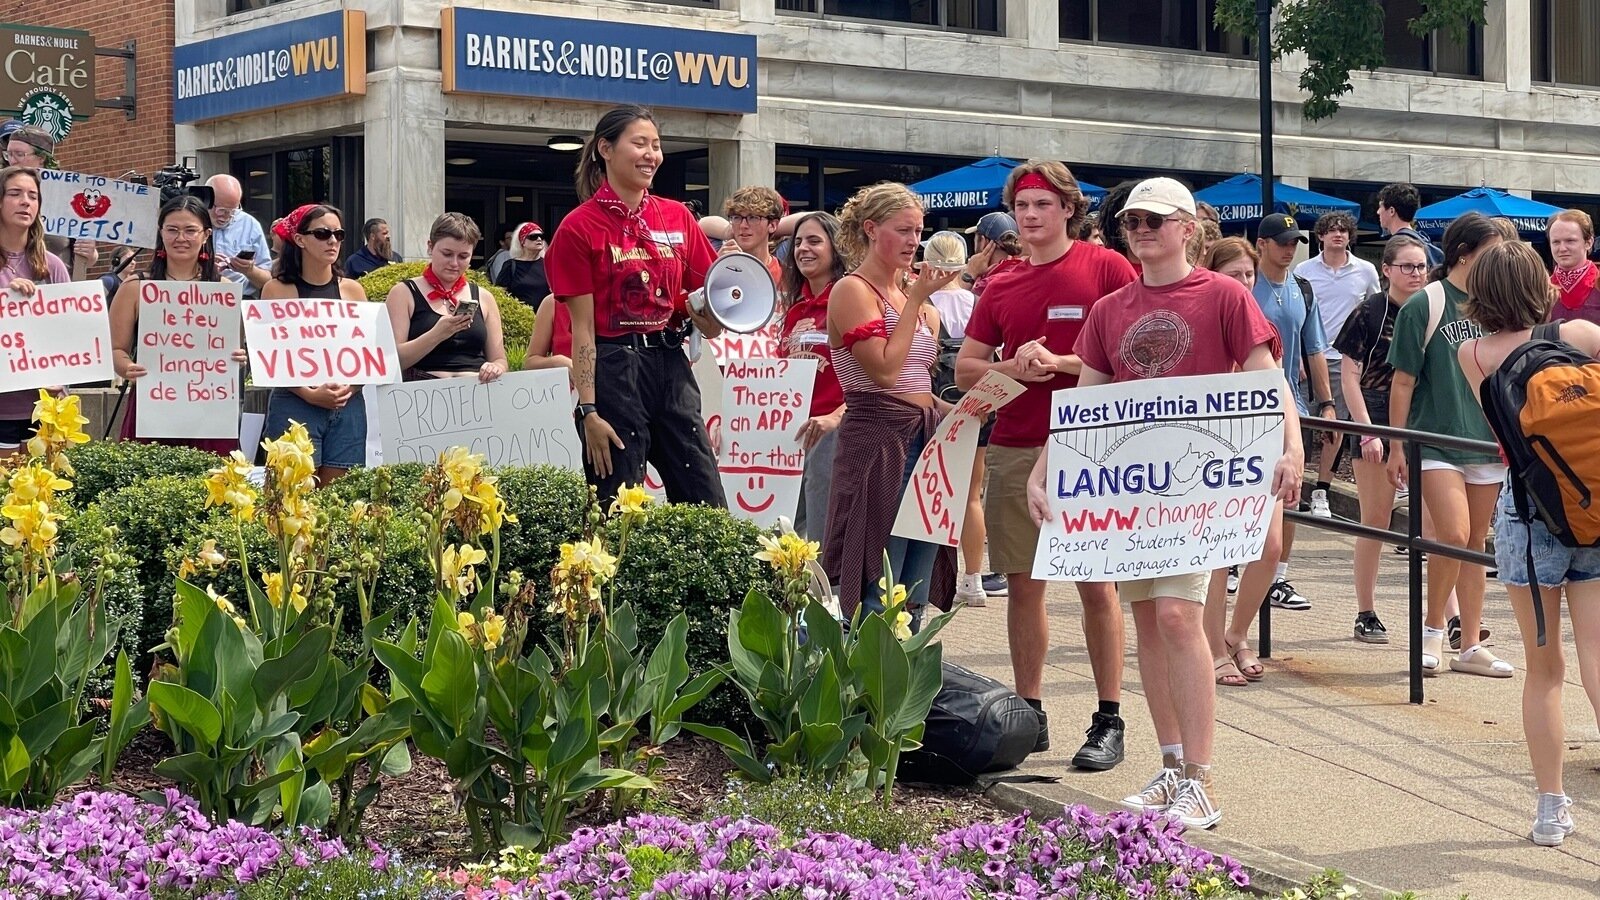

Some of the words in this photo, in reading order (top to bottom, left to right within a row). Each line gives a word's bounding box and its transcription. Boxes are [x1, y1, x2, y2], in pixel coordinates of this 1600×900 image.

[5, 49, 88, 88] Café
[26, 86, 57, 98] PROUDLY
[41, 170, 80, 183] OWER
[86, 176, 106, 187] TO
[114, 180, 149, 195] THE
[142, 283, 171, 304] On
[178, 283, 236, 307] allume
[163, 308, 177, 326] le
[182, 308, 218, 328] feu
[246, 303, 262, 321] A
[271, 301, 361, 320] BOWTIE
[143, 332, 195, 349] avec
[271, 325, 289, 340] IS
[300, 323, 338, 339] NOT
[351, 326, 365, 339] A
[8, 336, 102, 373] idiomas!
[257, 347, 387, 379] VISION
[160, 353, 227, 386] langue
[726, 359, 789, 379] Admin?
[150, 381, 177, 401] de
[187, 377, 235, 402] bois!
[733, 385, 803, 408] There's
[388, 383, 497, 438] PROTECT
[511, 383, 560, 410] our
[1058, 403, 1109, 425] West
[1115, 395, 1198, 423] Virginia
[1206, 389, 1280, 413] NEEDS
[731, 416, 750, 432] an
[757, 409, 793, 431] APP
[729, 441, 762, 465] for
[767, 445, 804, 468] that
[1049, 536, 1108, 553] Preserve
[1199, 526, 1238, 550] Rights
[1244, 525, 1262, 540] to
[1048, 555, 1093, 581] Study
[1103, 554, 1180, 577] Languages
[1190, 551, 1209, 567] at
[1223, 541, 1264, 560] WVU
